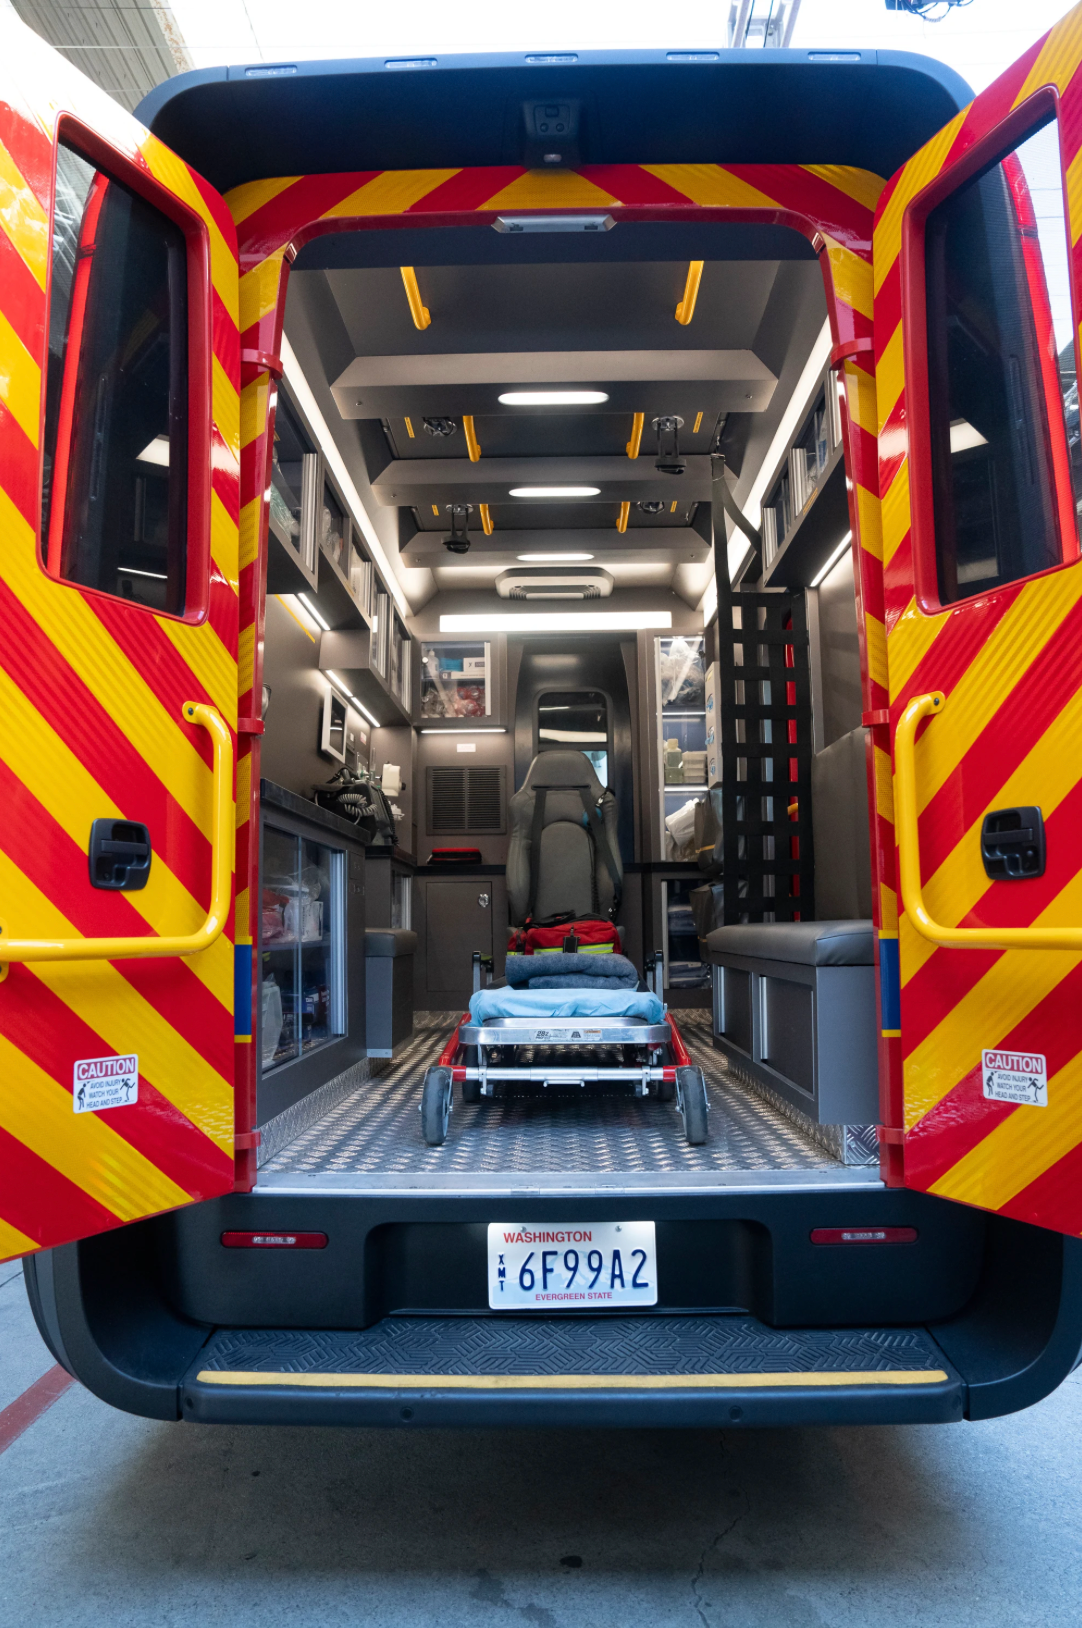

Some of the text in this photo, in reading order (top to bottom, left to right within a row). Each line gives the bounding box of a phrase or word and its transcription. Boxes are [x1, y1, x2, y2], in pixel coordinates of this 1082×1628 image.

[78, 1058, 135, 1079] CAUTION
[986, 1053, 1042, 1073] CAUTION
[997, 1073, 1028, 1083] AVOID INJURY
[90, 1079, 121, 1089] AVOID INJURY
[996, 1082, 1027, 1092] WATCH YOUR
[88, 1088, 119, 1099] WATCH YOUR
[995, 1090, 1008, 1098] HEAD
[1008, 1092, 1019, 1100] AND
[86, 1096, 122, 1108] HEAD AND STEP
[503, 1231, 592, 1243] WASHINGTON
[519, 1249, 649, 1291] 6F99A2
[535, 1292, 613, 1301] EVERGREEN STATE
